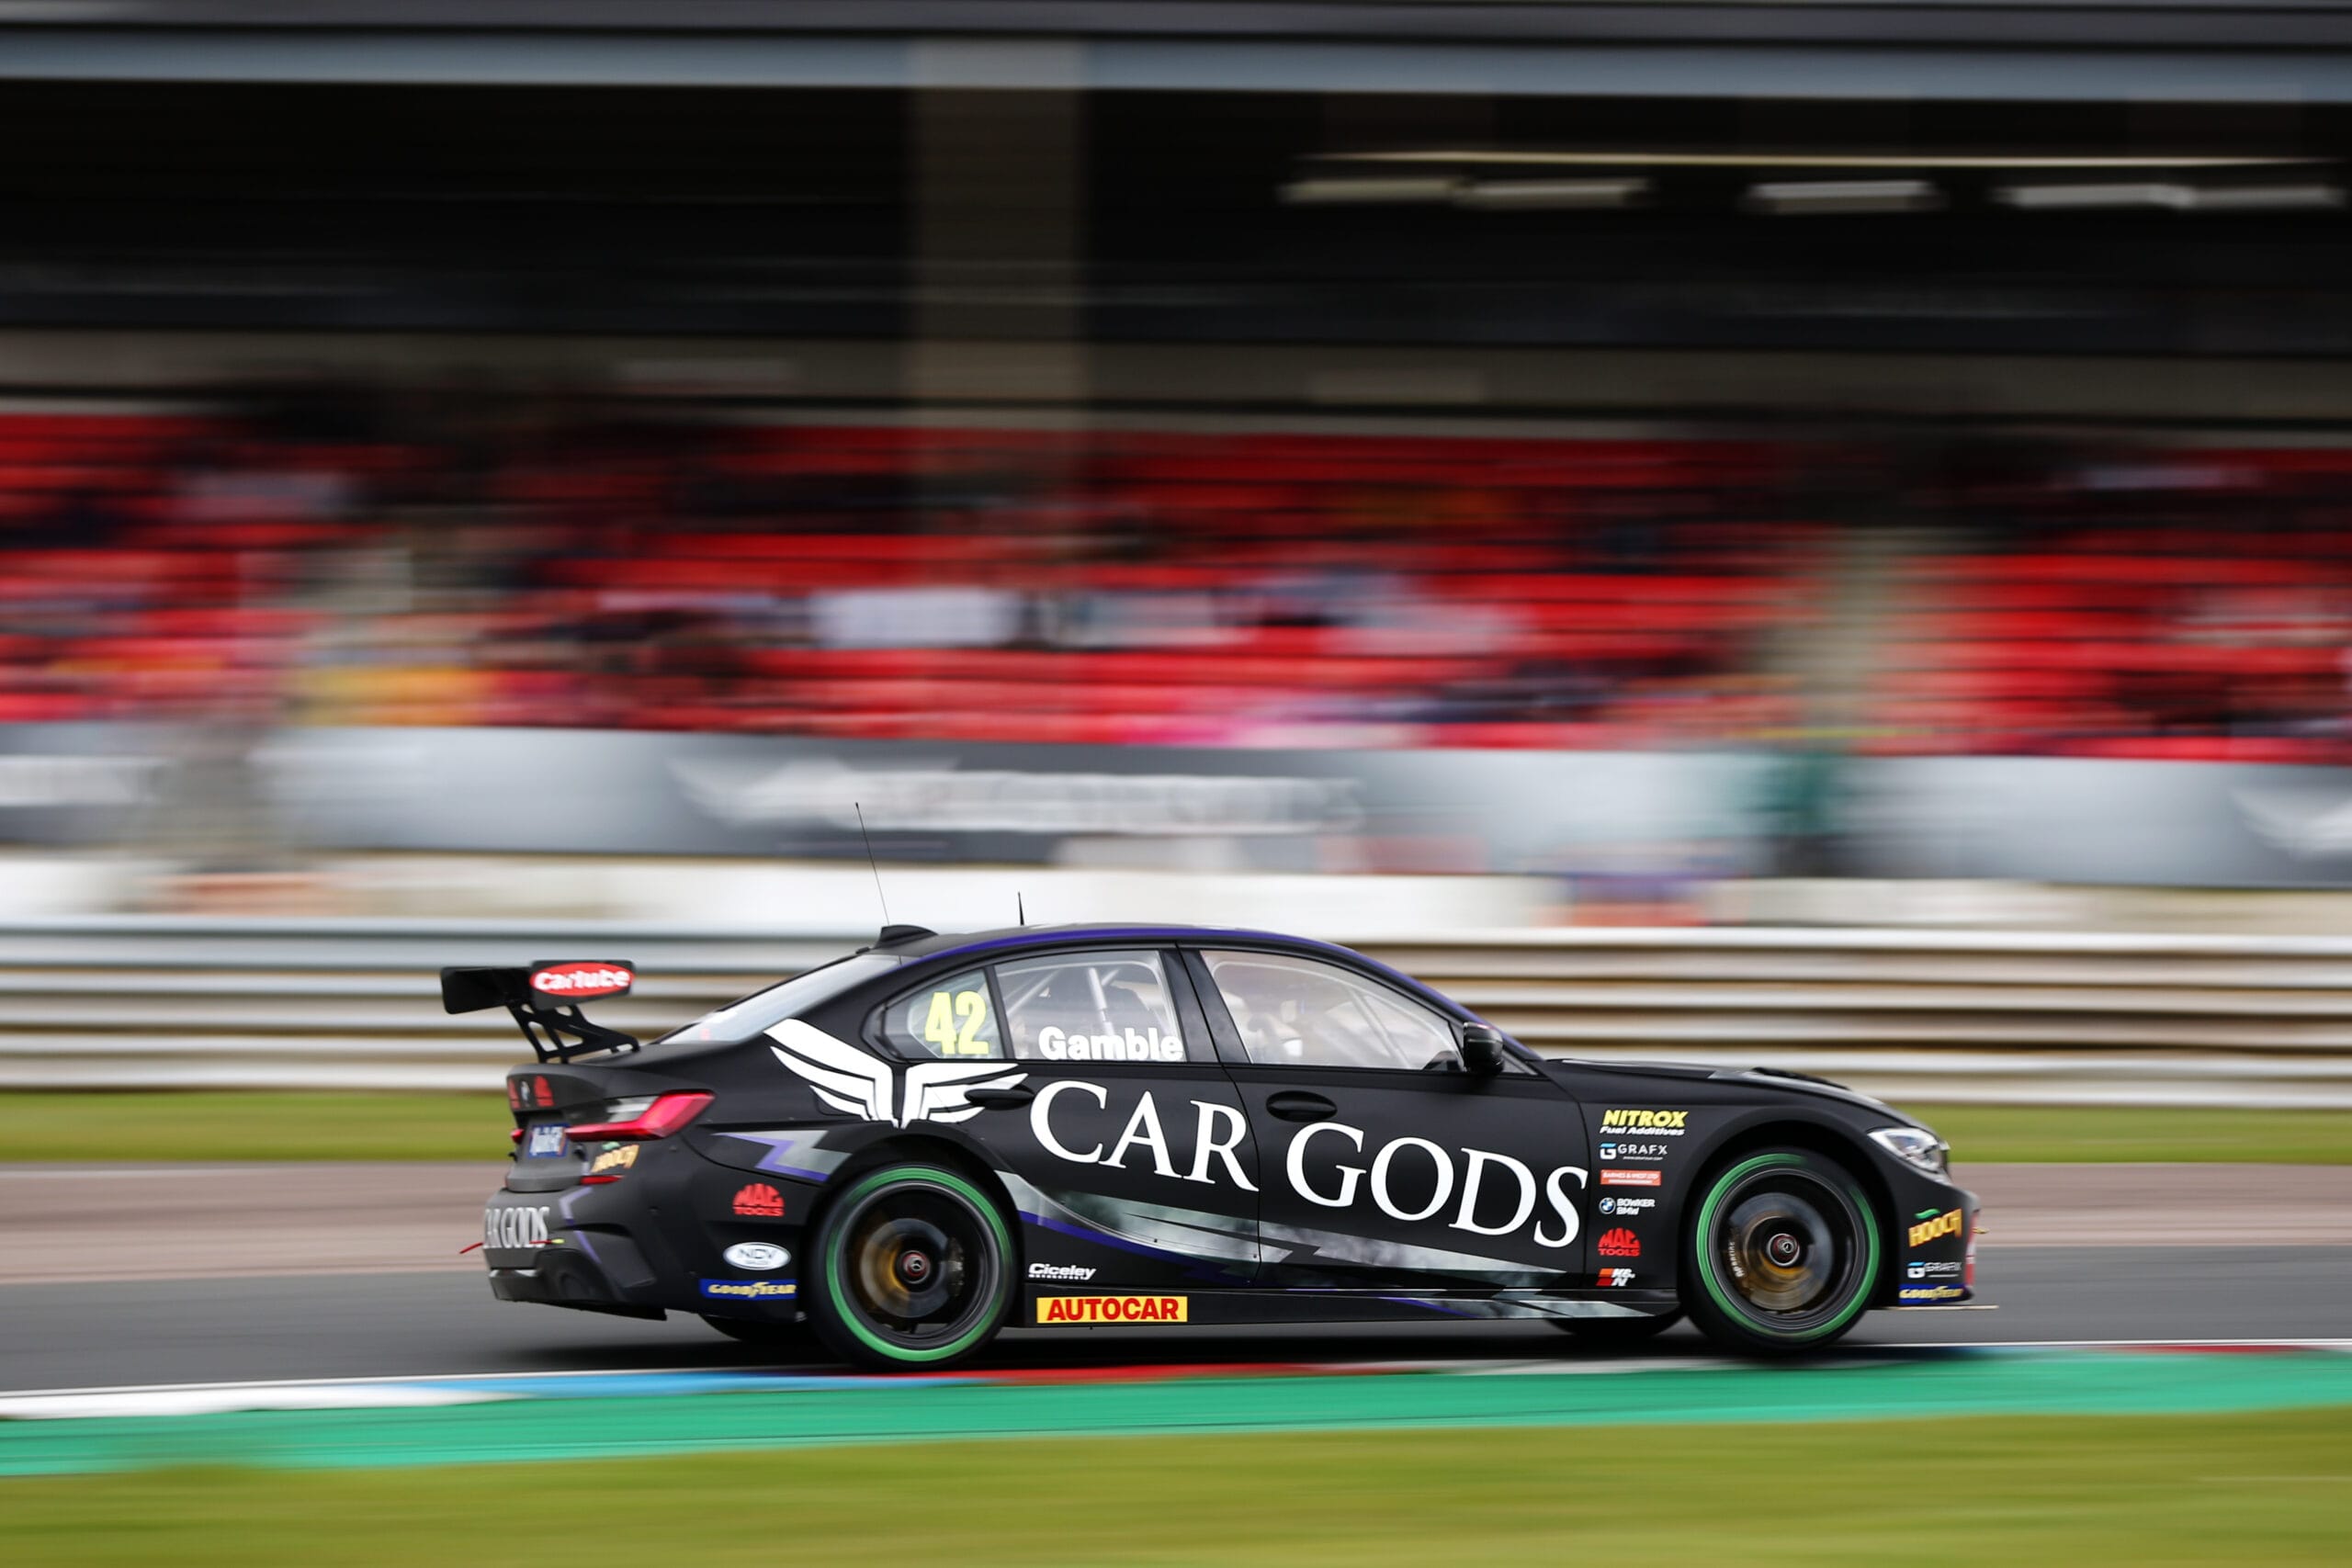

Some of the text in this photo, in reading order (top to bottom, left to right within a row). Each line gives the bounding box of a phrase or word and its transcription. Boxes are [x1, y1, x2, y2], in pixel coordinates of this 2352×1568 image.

[534, 969, 630, 991] Carlube
[924, 990, 990, 1055] 42
[1038, 1026, 1184, 1062] Gamble
[1602, 1110, 1689, 1128] NITROX
[1600, 1126, 1685, 1136] Fuel Additives
[1617, 1144, 1668, 1155] GRAFX
[1029, 1080, 1589, 1248] CAR GODS
[501, 1206, 550, 1248] GODS
[1598, 1227, 1641, 1248] MAC
[1598, 1247, 1641, 1257] TOOLS
[1029, 1263, 1097, 1280] Ciceley
[1046, 1297, 1179, 1321] AUTOCAR
